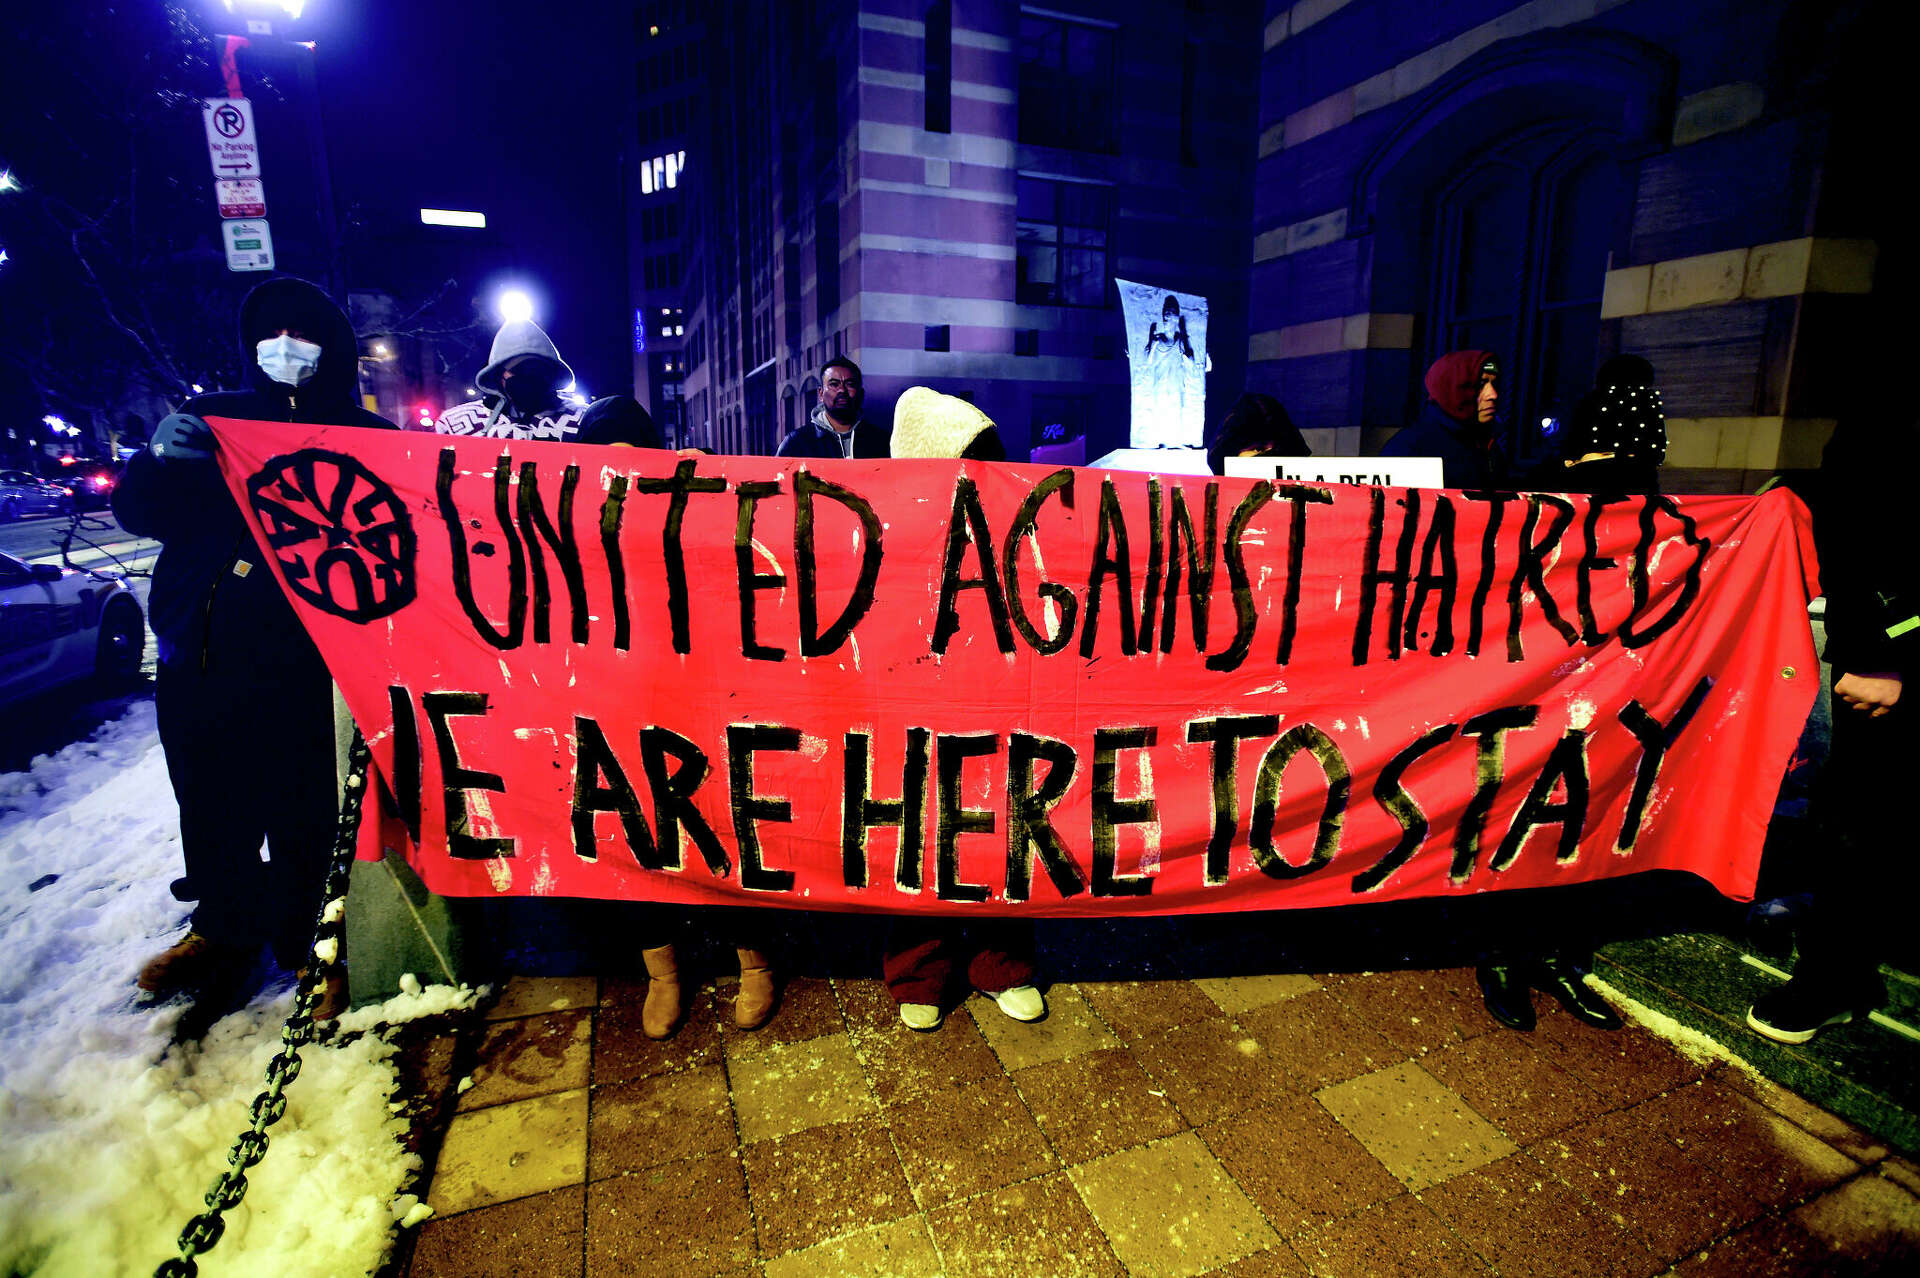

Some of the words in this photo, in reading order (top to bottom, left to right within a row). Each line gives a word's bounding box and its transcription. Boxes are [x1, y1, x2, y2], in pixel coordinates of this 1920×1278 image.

[437, 449, 883, 662] UNITED
[931, 468, 1334, 672] AGAINST
[1352, 488, 1710, 665] HATRED
[571, 717, 801, 891] ARE
[842, 727, 1160, 902] HERE
[1187, 715, 1351, 886] TO
[1352, 675, 1714, 893] STAY
